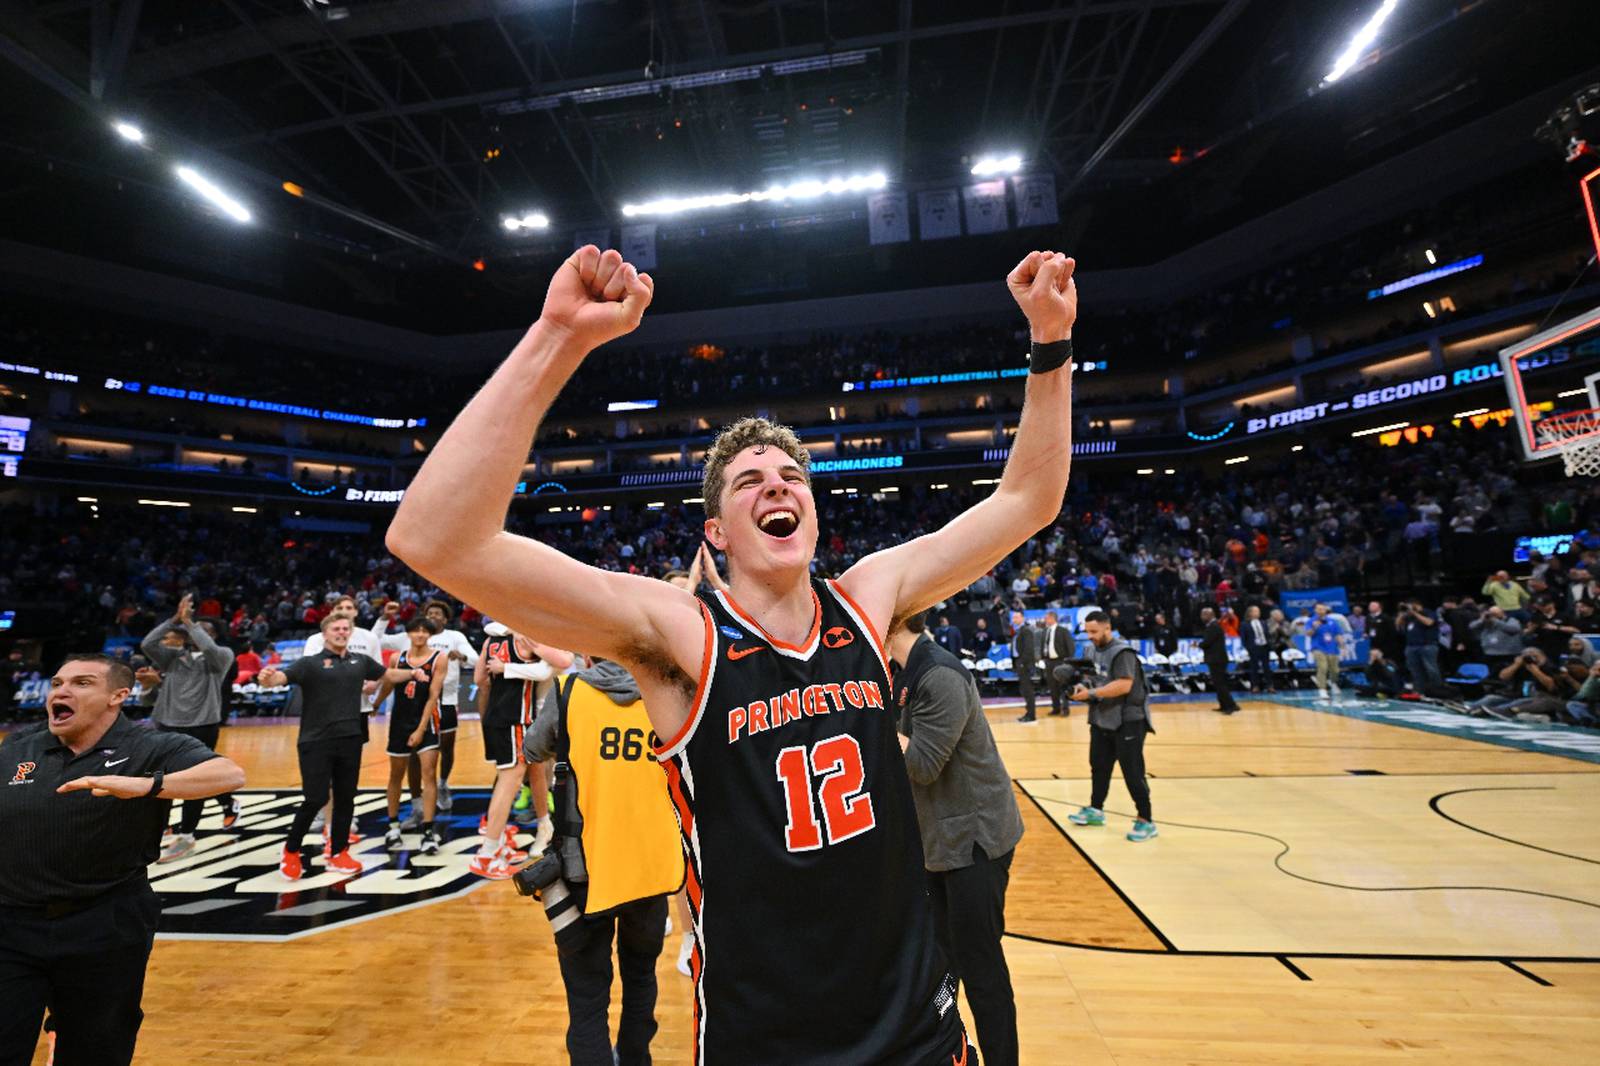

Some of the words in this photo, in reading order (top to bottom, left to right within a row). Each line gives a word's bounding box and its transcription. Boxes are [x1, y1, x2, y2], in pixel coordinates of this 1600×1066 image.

[940, 370, 998, 383] BASKETBALL
[148, 385, 186, 398] 2023
[207, 393, 247, 407] MEN'S
[248, 400, 321, 418] BASKETBALL
[322, 411, 404, 428] CHAMPIONSHIP
[1268, 403, 1329, 428] FIRST
[1351, 375, 1446, 409] SECOND
[808, 456, 903, 473] ARCHMADNESS
[728, 681, 884, 744] PRINCETON
[776, 733, 876, 852] 12
